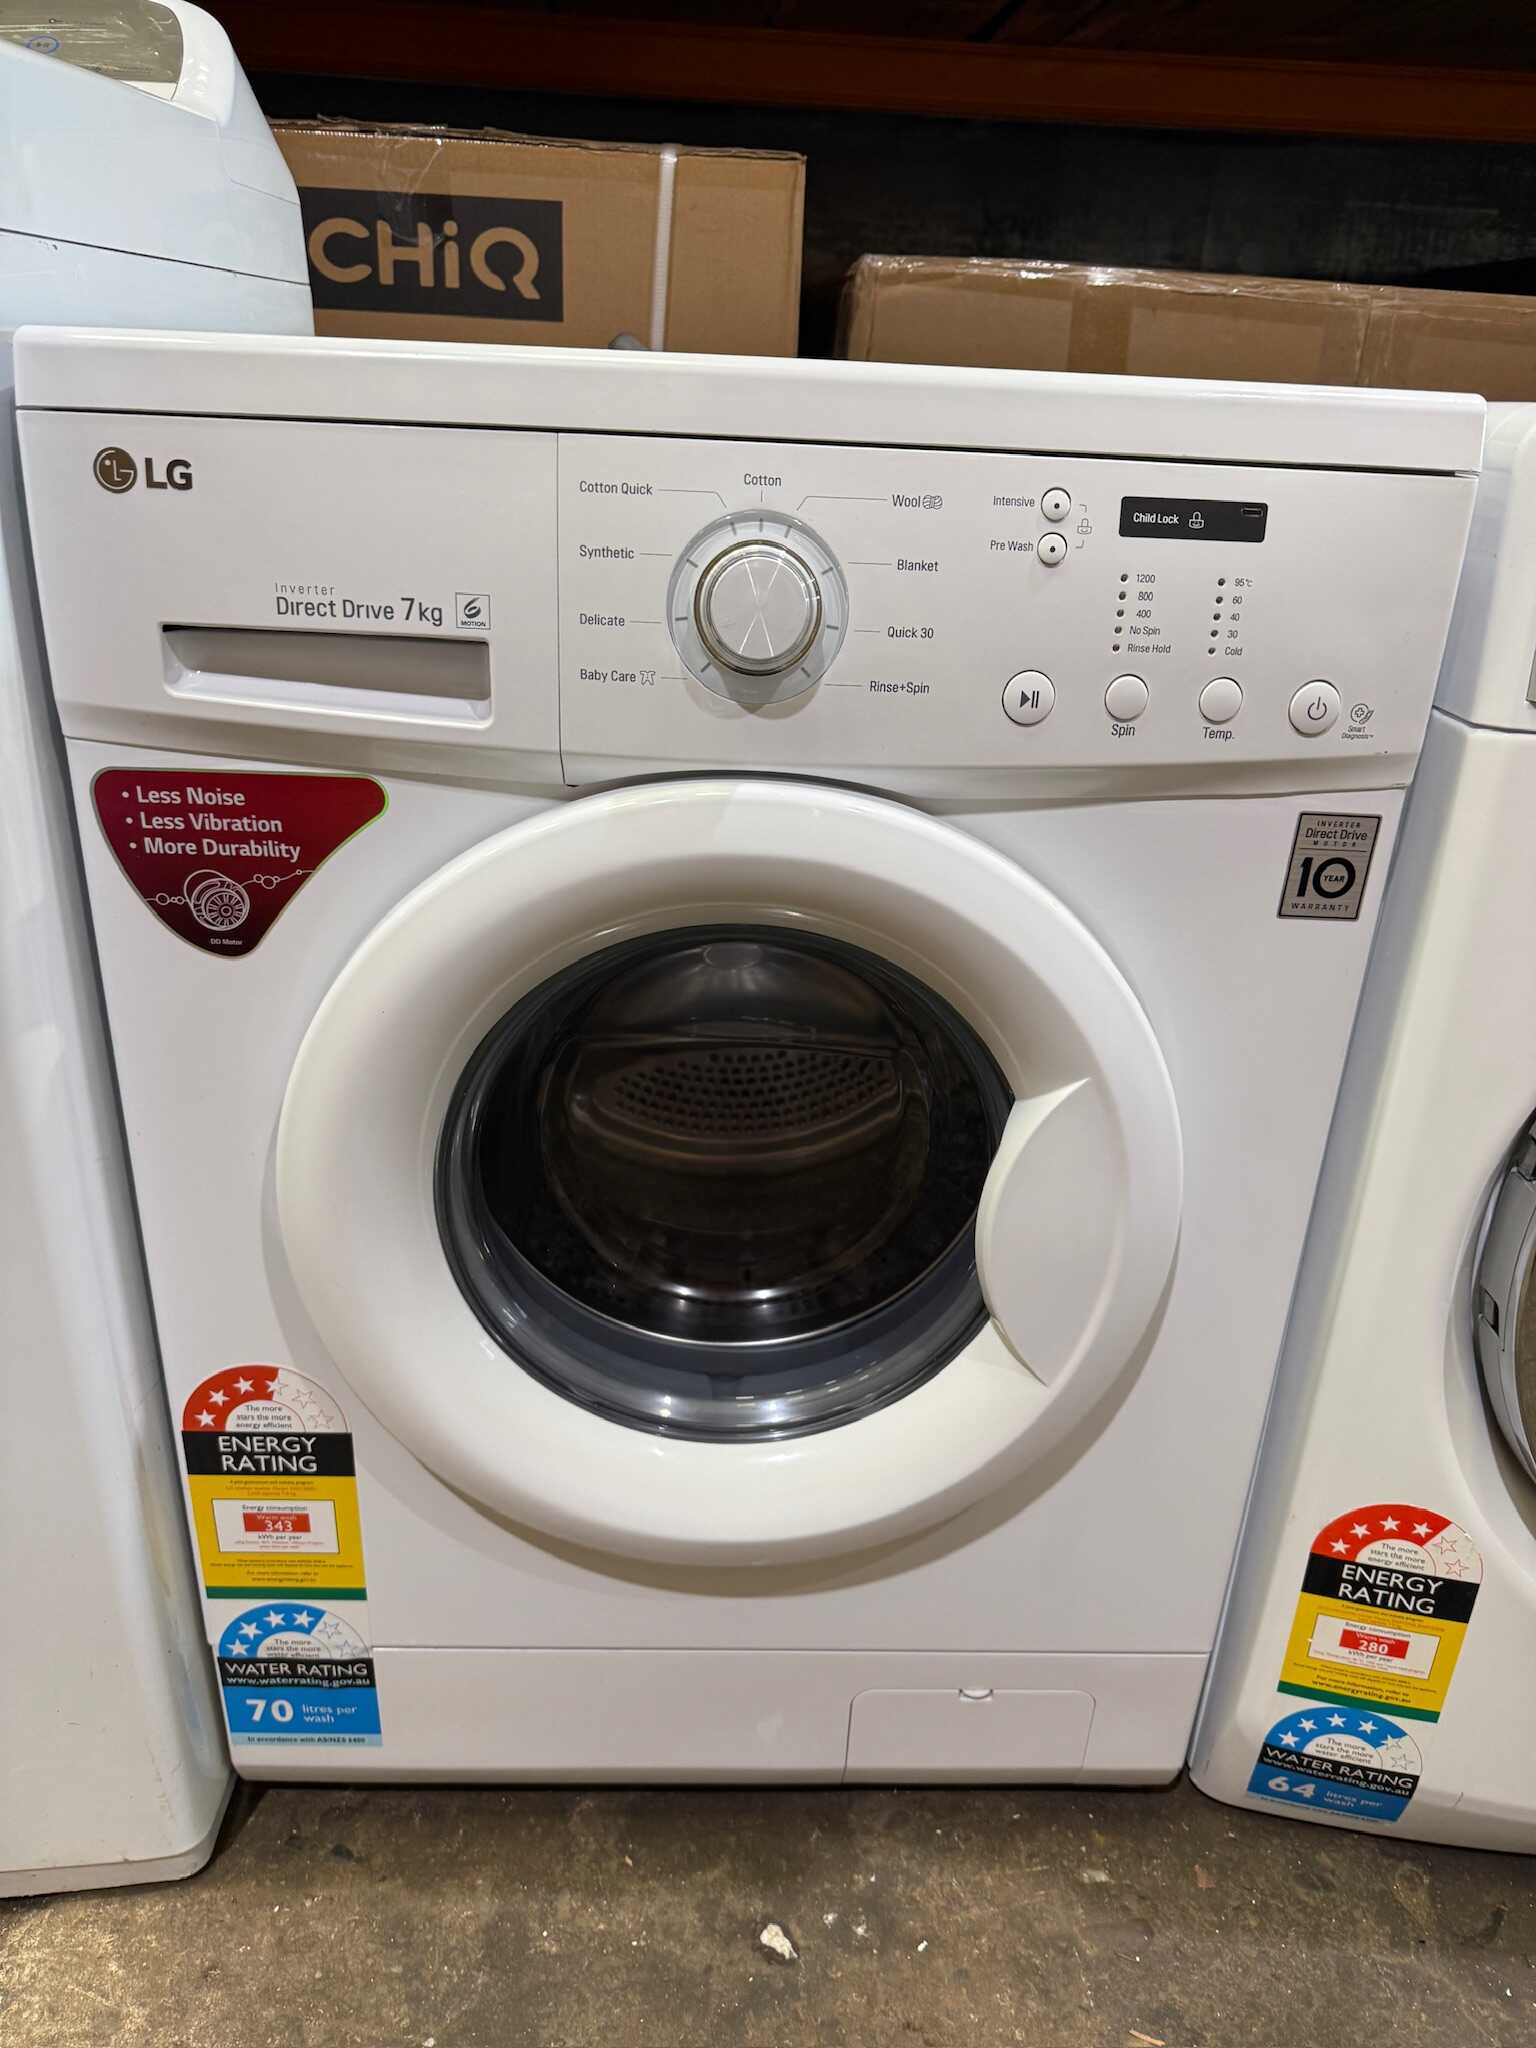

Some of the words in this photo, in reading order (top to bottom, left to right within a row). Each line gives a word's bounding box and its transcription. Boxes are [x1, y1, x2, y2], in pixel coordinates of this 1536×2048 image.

[309, 217, 540, 300] CHiQ
[145, 457, 193, 491] LG
[744, 474, 782, 487] Cotton
[579, 481, 618, 494] Cotton
[621, 483, 653, 496] Quick
[892, 495, 921, 508] Wool
[993, 495, 1035, 508] Intensive
[1133, 512, 1156, 524] Child
[1157, 513, 1179, 525] Lock
[579, 545, 635, 560] Synthetic
[990, 540, 1006, 552] Pre
[1007, 540, 1034, 553] Wash
[897, 559, 939, 573] Blanket
[1136, 574, 1155, 583] 1200
[275, 582, 336, 596] Inverter
[1138, 591, 1153, 601] 800
[1232, 596, 1243, 604] 60
[276, 596, 337, 619] Direct
[343, 599, 395, 621] Drive
[1136, 609, 1151, 618] 400
[579, 614, 625, 627] Delicate
[1230, 613, 1240, 622] 40
[887, 626, 918, 639] Quick
[921, 627, 934, 639] 30
[1129, 625, 1141, 635] No
[1142, 625, 1160, 637] Spin
[1227, 630, 1238, 639] 30
[1127, 643, 1150, 653] Rinse
[1152, 644, 1171, 653] Hold
[1225, 646, 1243, 656] Cold
[580, 669, 608, 684] Baby
[611, 671, 637, 683] Care
[869, 681, 930, 694] Rinse+Spin
[1111, 723, 1136, 738] Spin
[1202, 726, 1235, 742] Temp.
[1347, 725, 1366, 733] Smart
[136, 785, 181, 804] Less
[186, 787, 246, 806] Noise
[140, 811, 185, 830] Less
[188, 812, 282, 833] Vibration
[1317, 820, 1361, 828] INVERTER
[1305, 828, 1338, 840] Direct
[1339, 829, 1368, 841] Drive
[144, 837, 197, 855] More
[203, 838, 300, 862] Durability
[1296, 856, 1356, 899] 10
[1323, 874, 1346, 884] YEAR
[1290, 902, 1350, 913] WARRANTY
[222, 938, 243, 946] Motor
[236, 1422, 261, 1430] energy
[218, 1435, 317, 1454] ENERGY
[221, 1455, 318, 1473] RATING
[242, 1504, 264, 1512] Energy
[264, 1520, 294, 1531] 343
[1381, 1543, 1396, 1551] The
[1370, 1549, 1389, 1557] stars
[1404, 1556, 1426, 1564] more
[1367, 1556, 1393, 1566] energy
[1395, 1560, 1425, 1571] efficient
[1341, 1564, 1443, 1595] ENERGY
[1338, 1583, 1436, 1614] RATING
[1359, 1640, 1388, 1654] 280
[225, 1662, 291, 1675] WATER
[297, 1663, 368, 1677] RATING
[227, 1676, 370, 1688] www.waterrating.gov.au
[245, 1698, 294, 1723] 70
[302, 1703, 333, 1713] litres
[336, 1706, 357, 1716] per
[304, 1714, 335, 1723] wash
[1327, 1737, 1342, 1745] The
[1344, 1742, 1366, 1750] more
[1315, 1743, 1335, 1751] stars
[1337, 1746, 1350, 1754] the
[1351, 1750, 1374, 1759] more
[1315, 1749, 1338, 1758] water
[1340, 1753, 1371, 1764] efficient
[1266, 1747, 1332, 1772] WATER
[1339, 1767, 1413, 1788] RATING
[1263, 1757, 1410, 1796] www.waterrating.gov.au
[1268, 1776, 1316, 1798] 64
[1327, 1790, 1357, 1801] litres
[1360, 1799, 1383, 1808] per
[1324, 1798, 1354, 1807] wash
